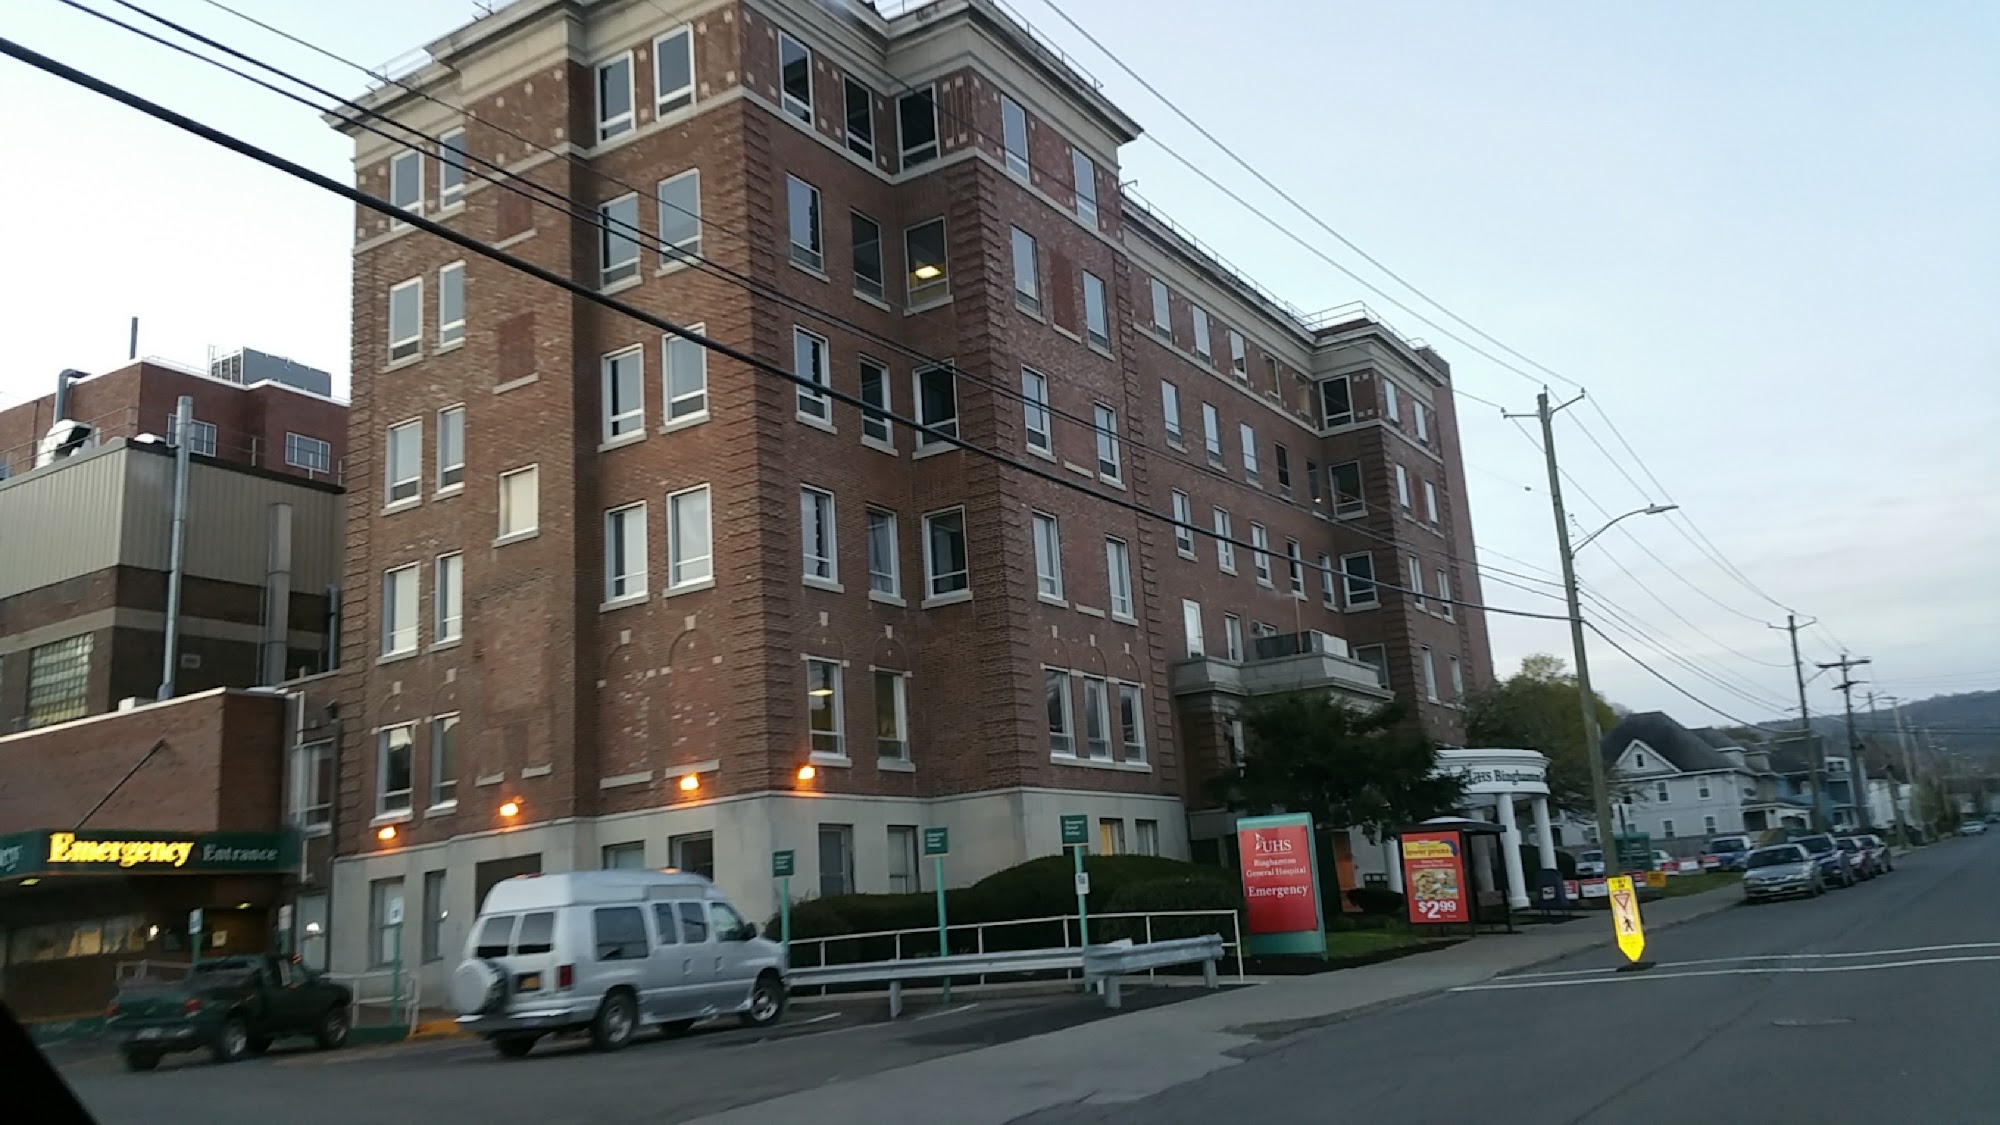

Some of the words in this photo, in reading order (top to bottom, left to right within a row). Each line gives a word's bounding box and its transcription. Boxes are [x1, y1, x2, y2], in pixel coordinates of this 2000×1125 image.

[47, 832, 195, 867] Emergency
[203, 843, 278, 862] Entrance
[1262, 840, 1292, 852] UHS
[1253, 858, 1297, 867] Binghamton
[1246, 868, 1274, 878] General
[1275, 866, 1307, 876] Hospital
[1248, 885, 1309, 898] Emergency
